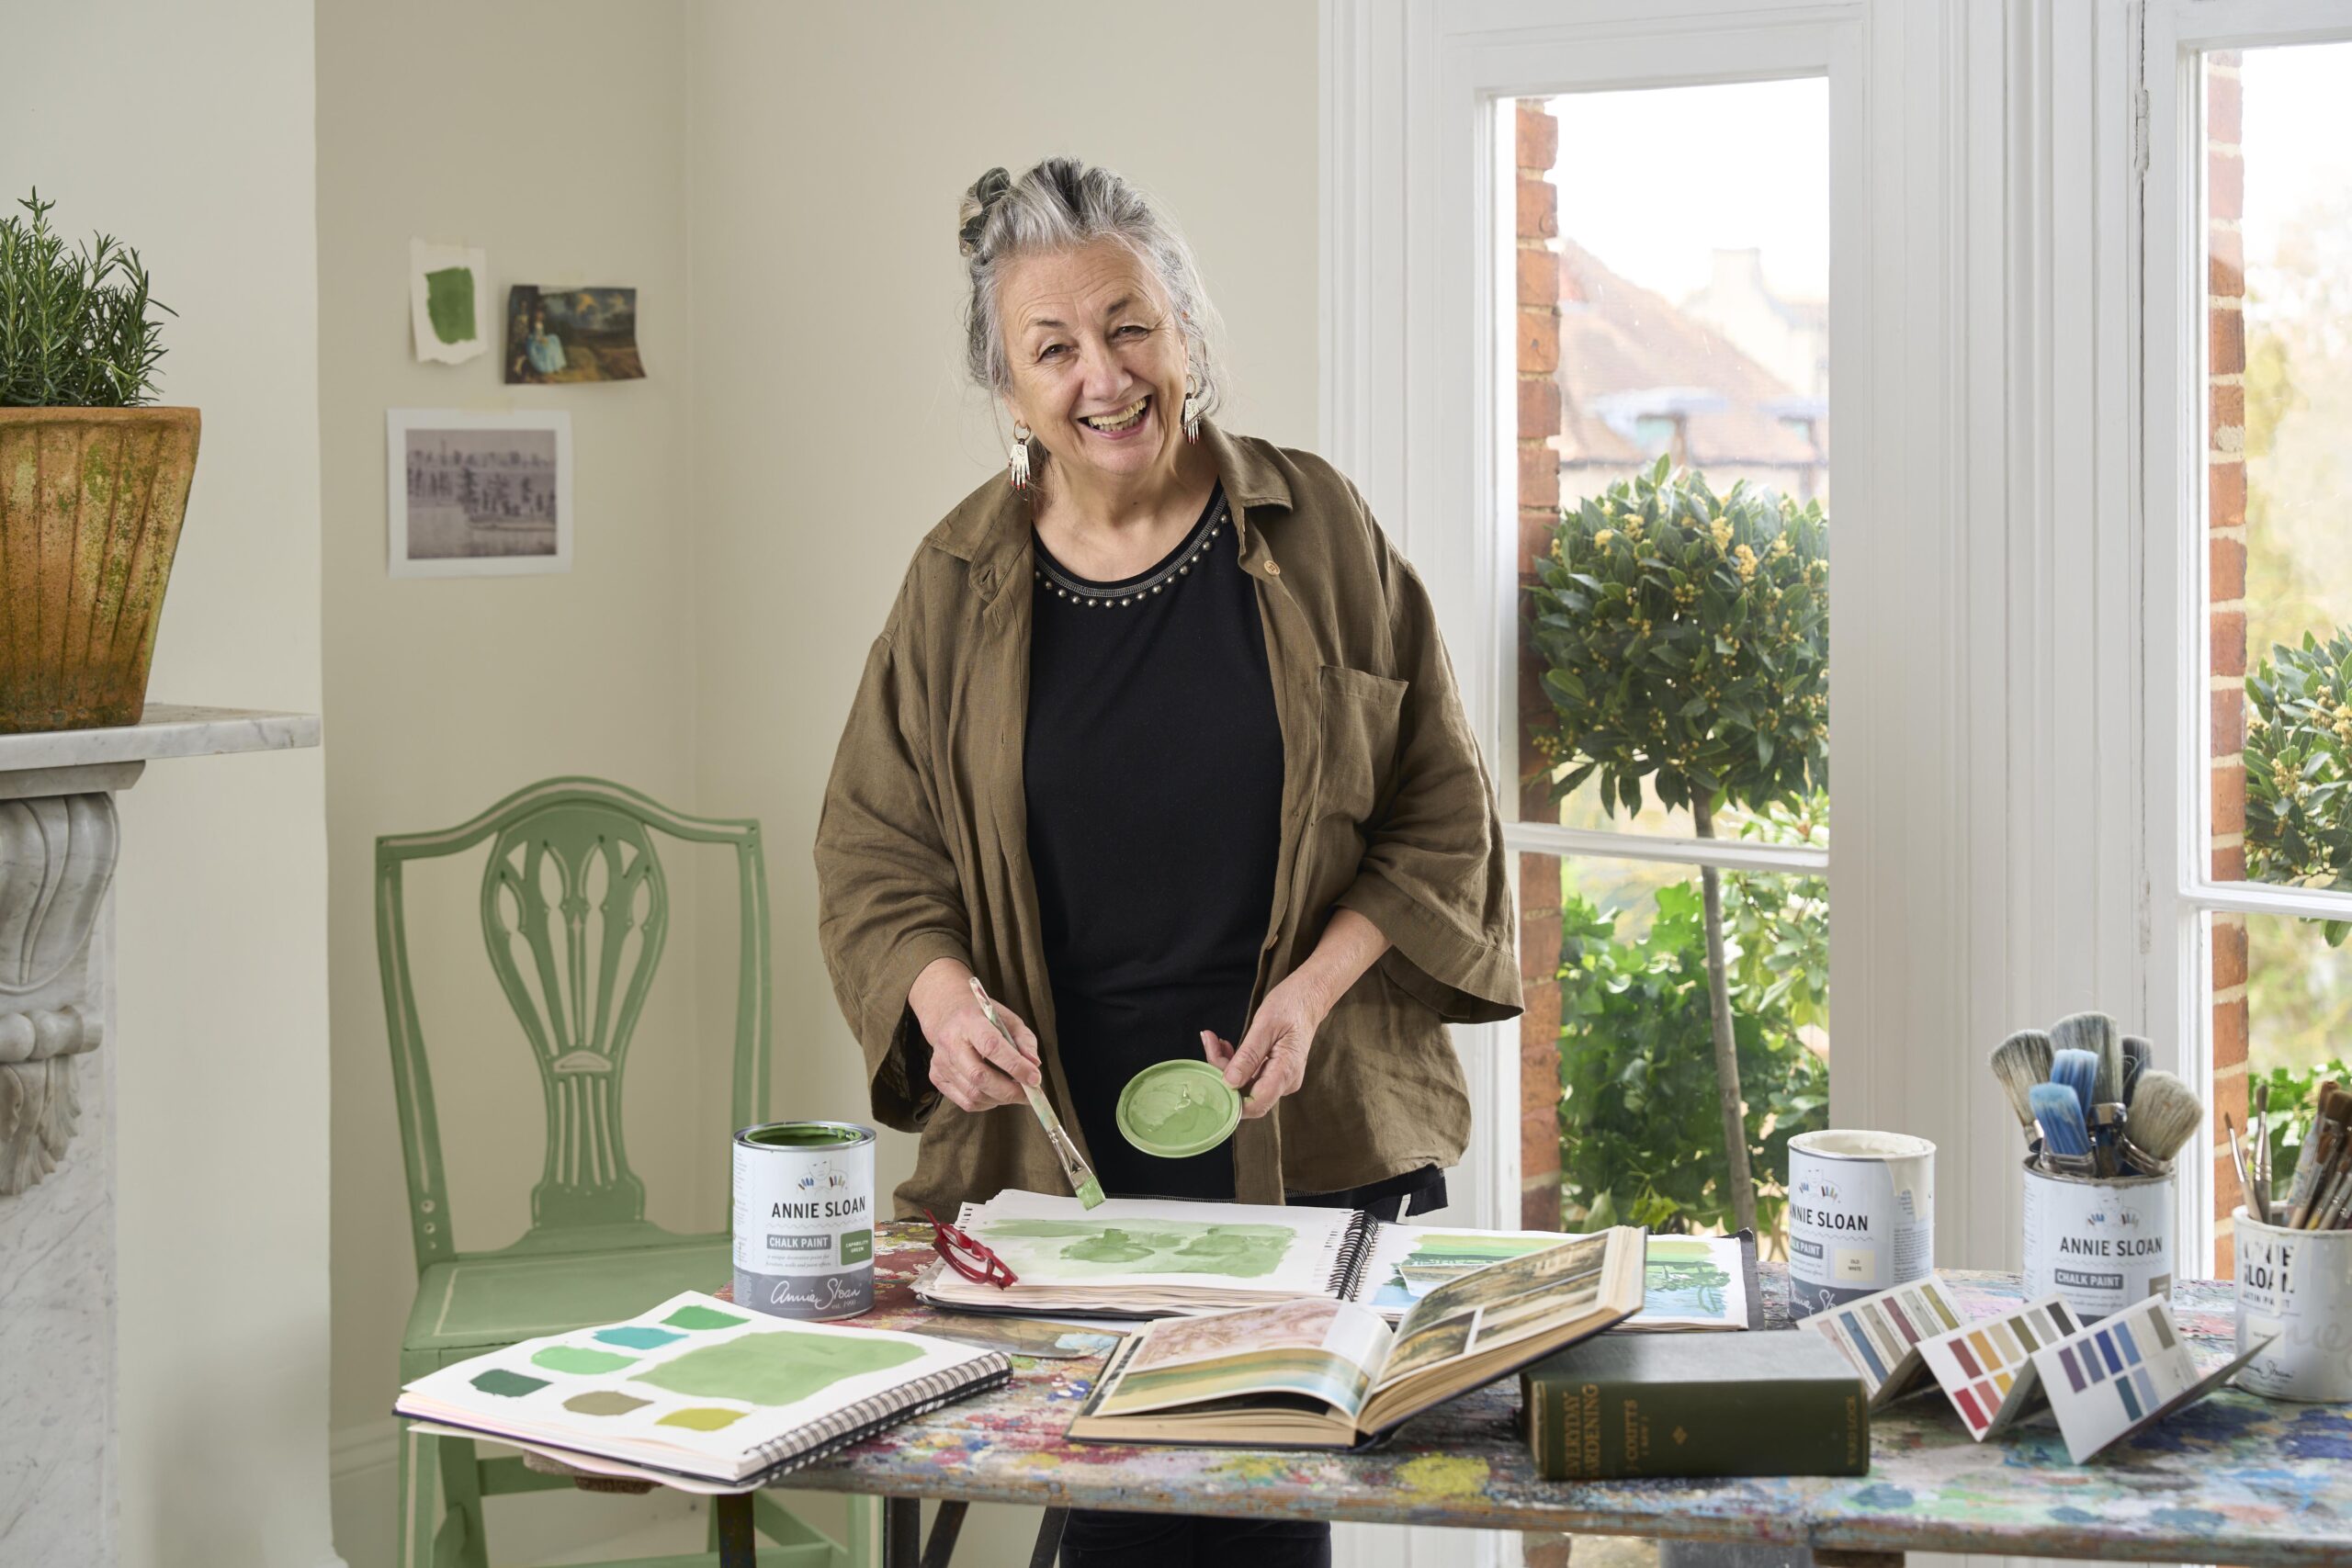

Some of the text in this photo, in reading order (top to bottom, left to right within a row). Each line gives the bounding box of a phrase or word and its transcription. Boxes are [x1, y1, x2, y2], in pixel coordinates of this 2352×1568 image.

[772, 1196, 865, 1219] ANNIE SLOAN
[1817, 1211, 1868, 1232] SLOAN
[769, 1236, 829, 1248] CHALK PAINT
[1801, 1242, 1821, 1256] PAINT
[2059, 1236, 2163, 1258] ANNIE SLOAN
[2057, 1271, 2120, 1287] CHALK PAINT
[770, 1278, 862, 1311] Annie Sloan
[2264, 1296, 2290, 1309] PAT
[1581, 1383, 1600, 1475] ARDENING
